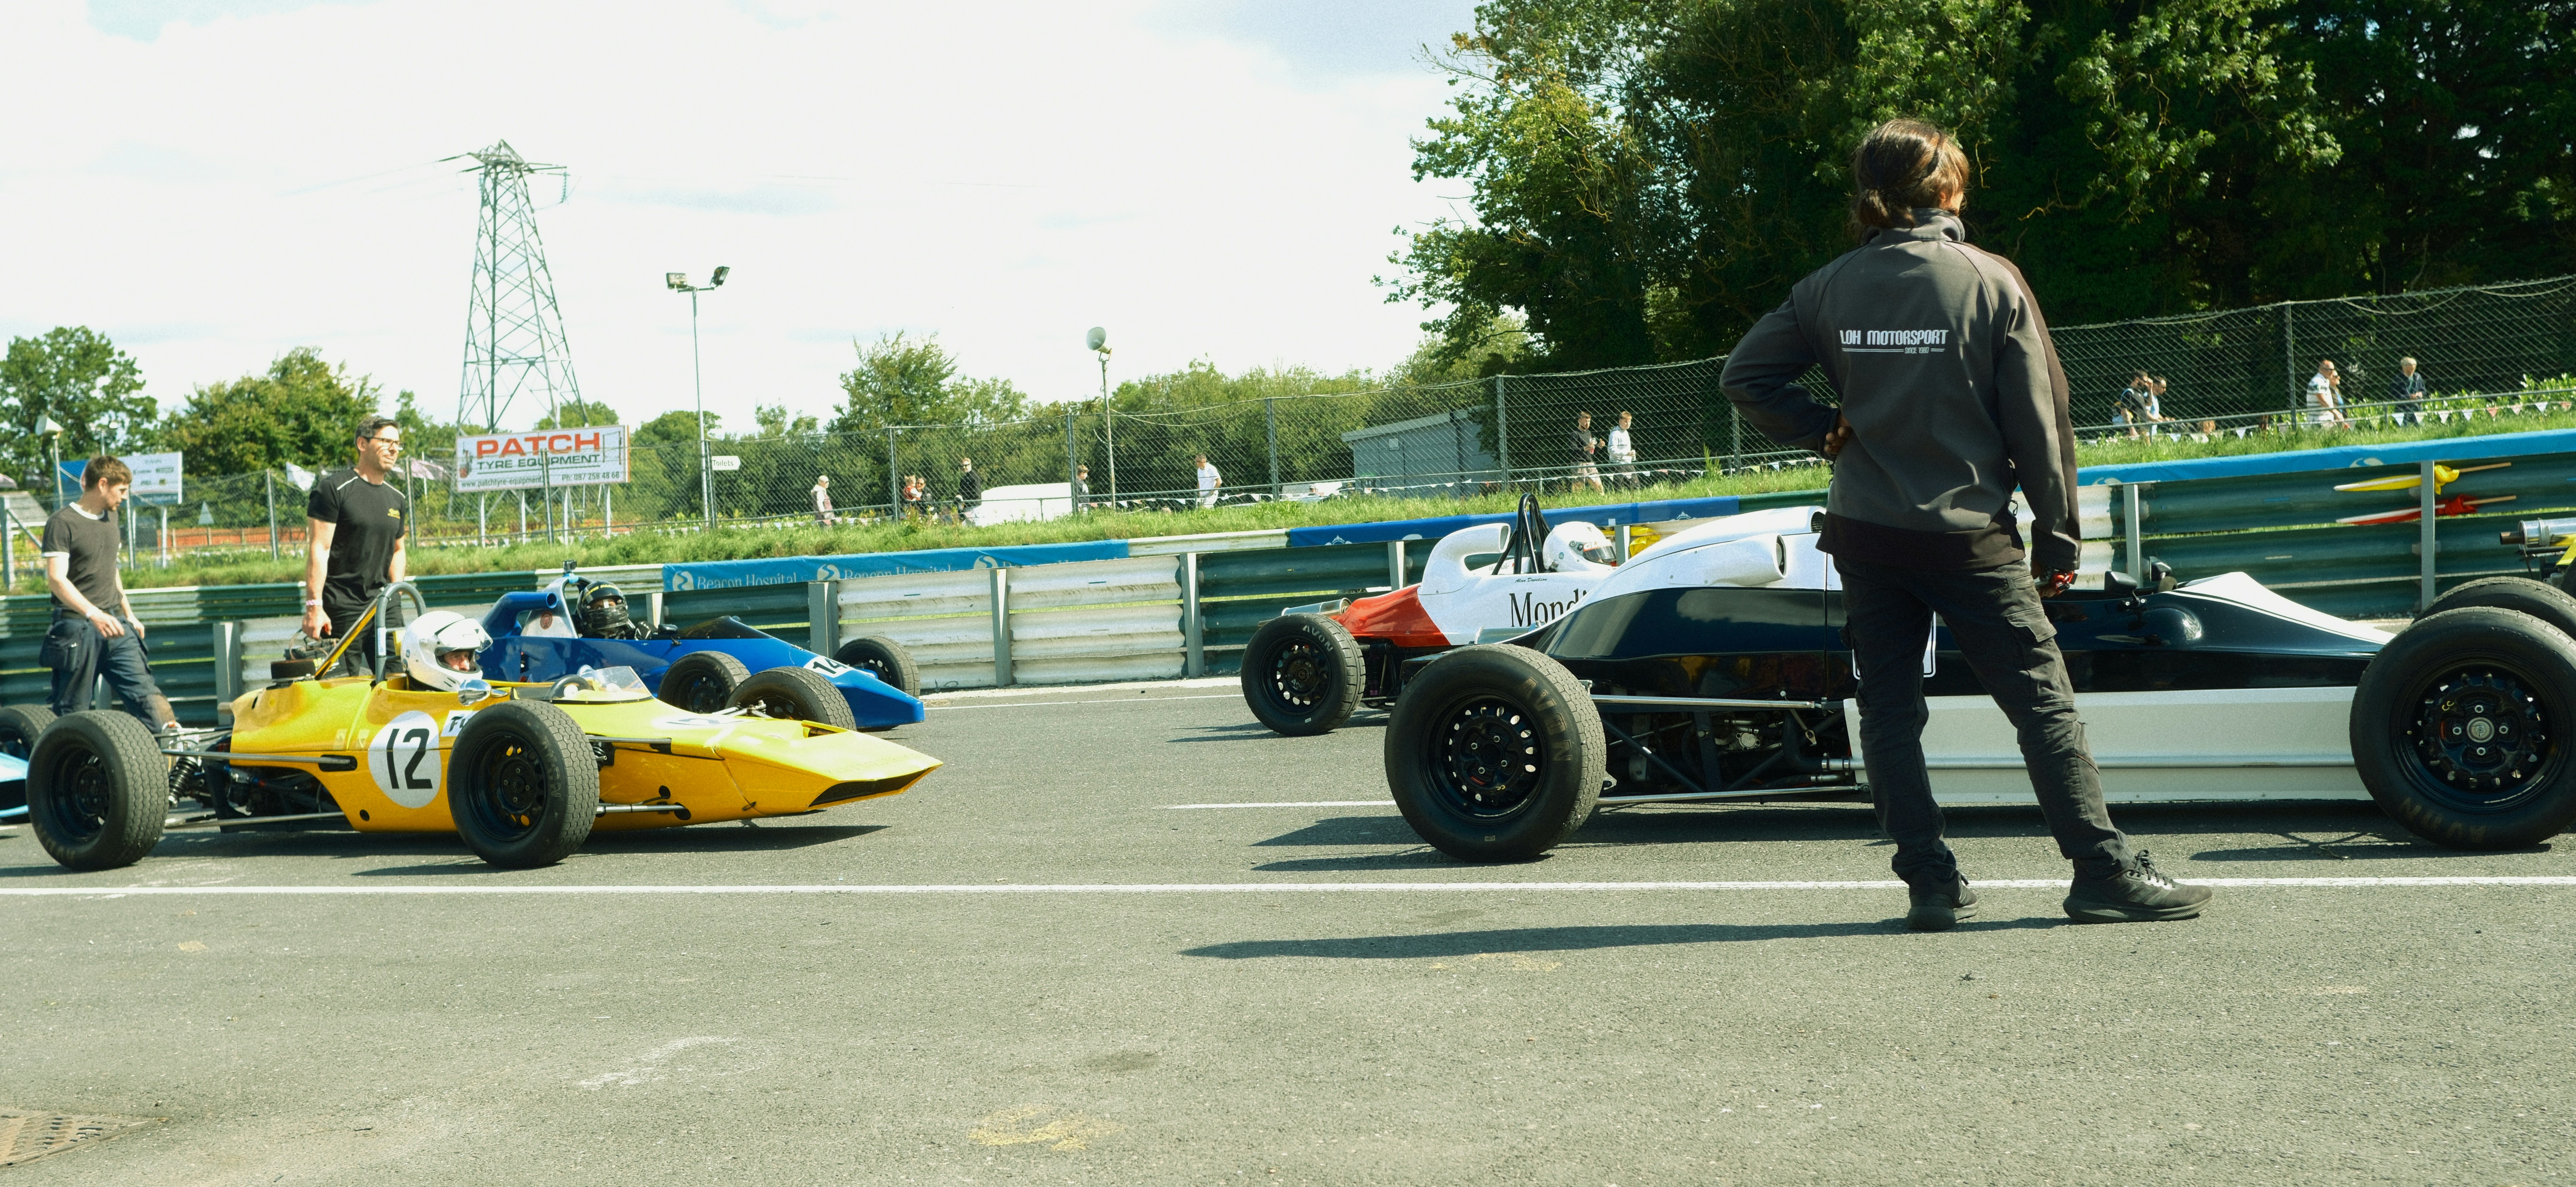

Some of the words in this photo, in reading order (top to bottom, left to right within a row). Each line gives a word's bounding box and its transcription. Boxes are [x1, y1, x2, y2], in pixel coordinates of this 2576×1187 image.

[1840, 330, 1861, 345] LOH
[1867, 330, 1949, 345] MOTORSPORT
[477, 432, 600, 460] PATCH
[477, 459, 513, 470] TYRE
[518, 454, 600, 468] EQUIPMENT
[698, 576, 742, 590] Beacon
[746, 572, 797, 586] Hospital
[1302, 624, 1333, 652] AVON
[813, 658, 848, 674] 14
[1520, 677, 1572, 761] AVON
[386, 728, 433, 789] 12
